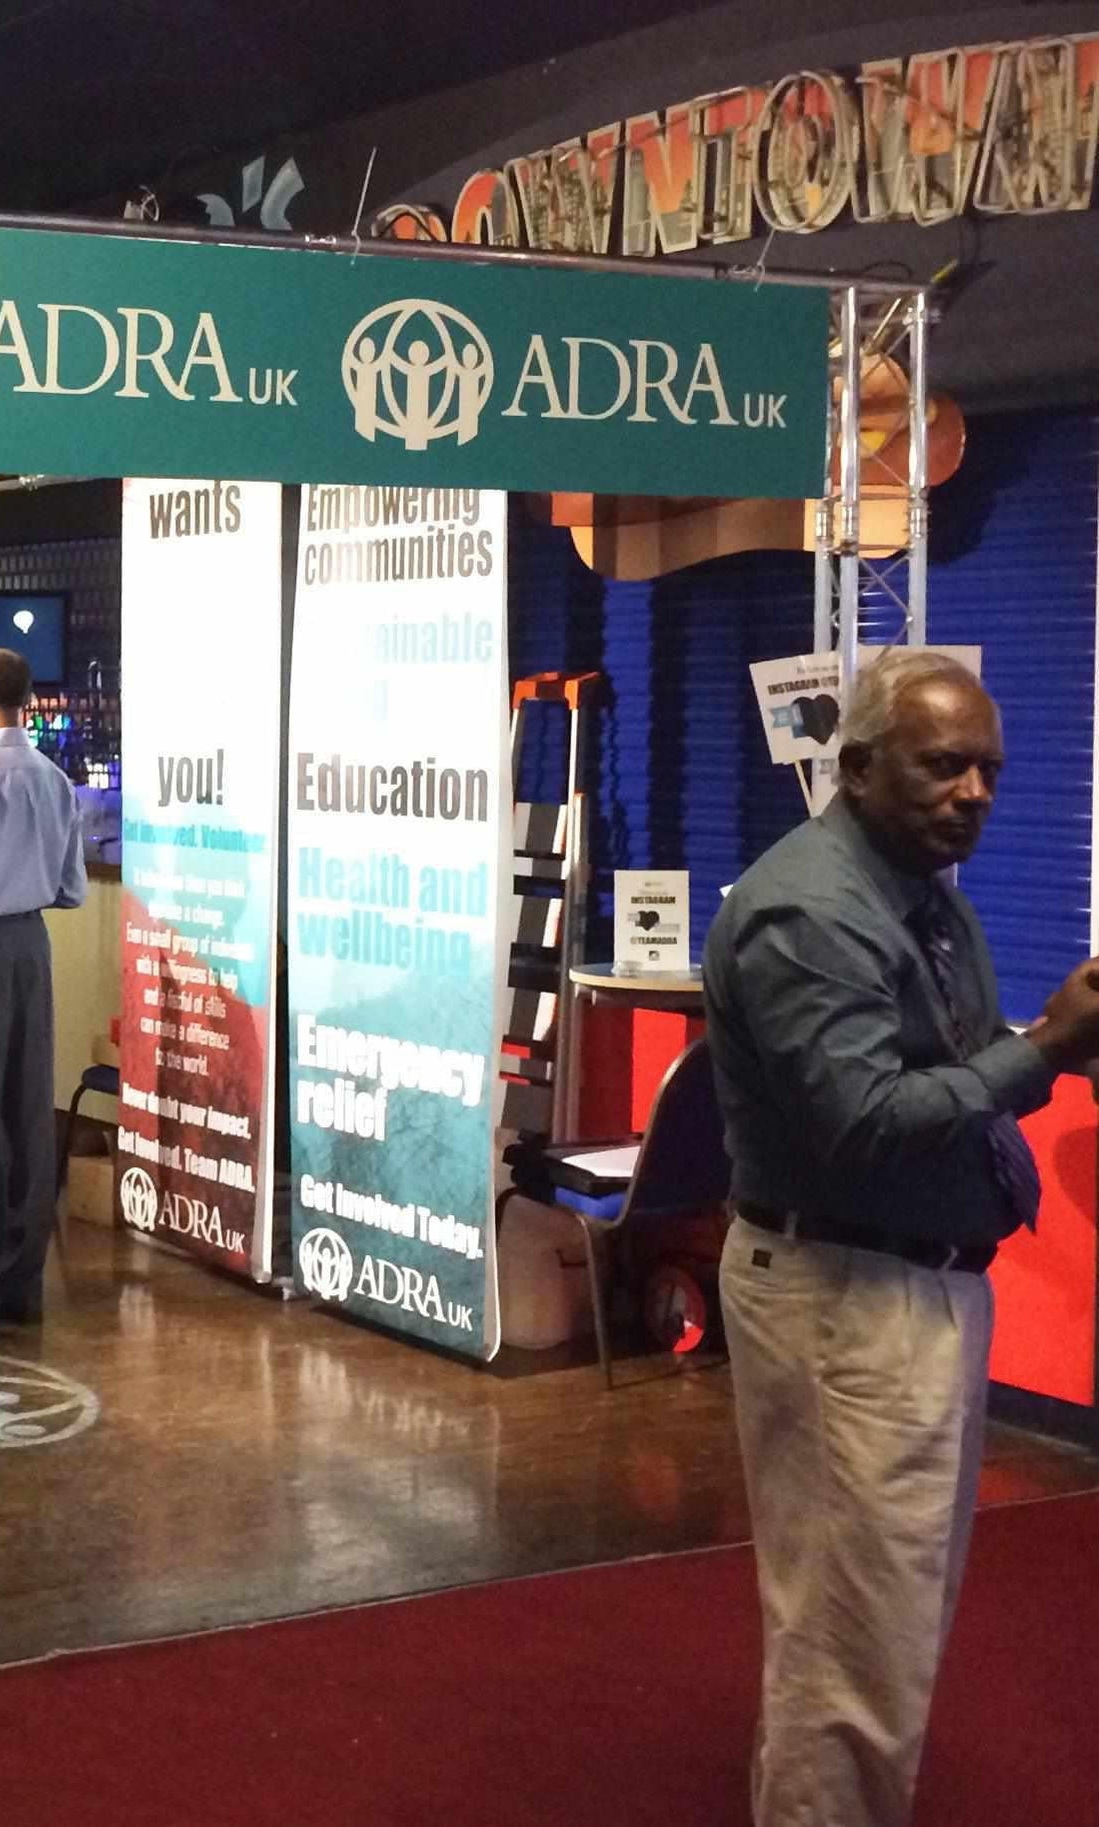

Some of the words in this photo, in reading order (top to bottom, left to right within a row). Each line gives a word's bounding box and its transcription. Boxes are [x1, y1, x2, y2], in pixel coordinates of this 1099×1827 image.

[368, 32, 1099, 258] OWNTOWN
[249, 367, 298, 406] UK
[502, 334, 739, 424] ADRA
[744, 394, 787, 427] UK
[149, 481, 242, 538] wants
[305, 525, 494, 586] communities
[157, 748, 225, 807] you!
[296, 752, 489, 822] Education
[298, 846, 411, 909] Health
[417, 861, 488, 918] and
[297, 909, 471, 977] wellbeing
[296, 1013, 486, 1108] Emergency
[296, 1077, 389, 1142] relief
[158, 1190, 226, 1249] ADRA
[225, 1228, 246, 1254] UK
[300, 1173, 335, 1214] Get
[353, 1254, 448, 1324] ADRA
[447, 1300, 474, 1332] UK
